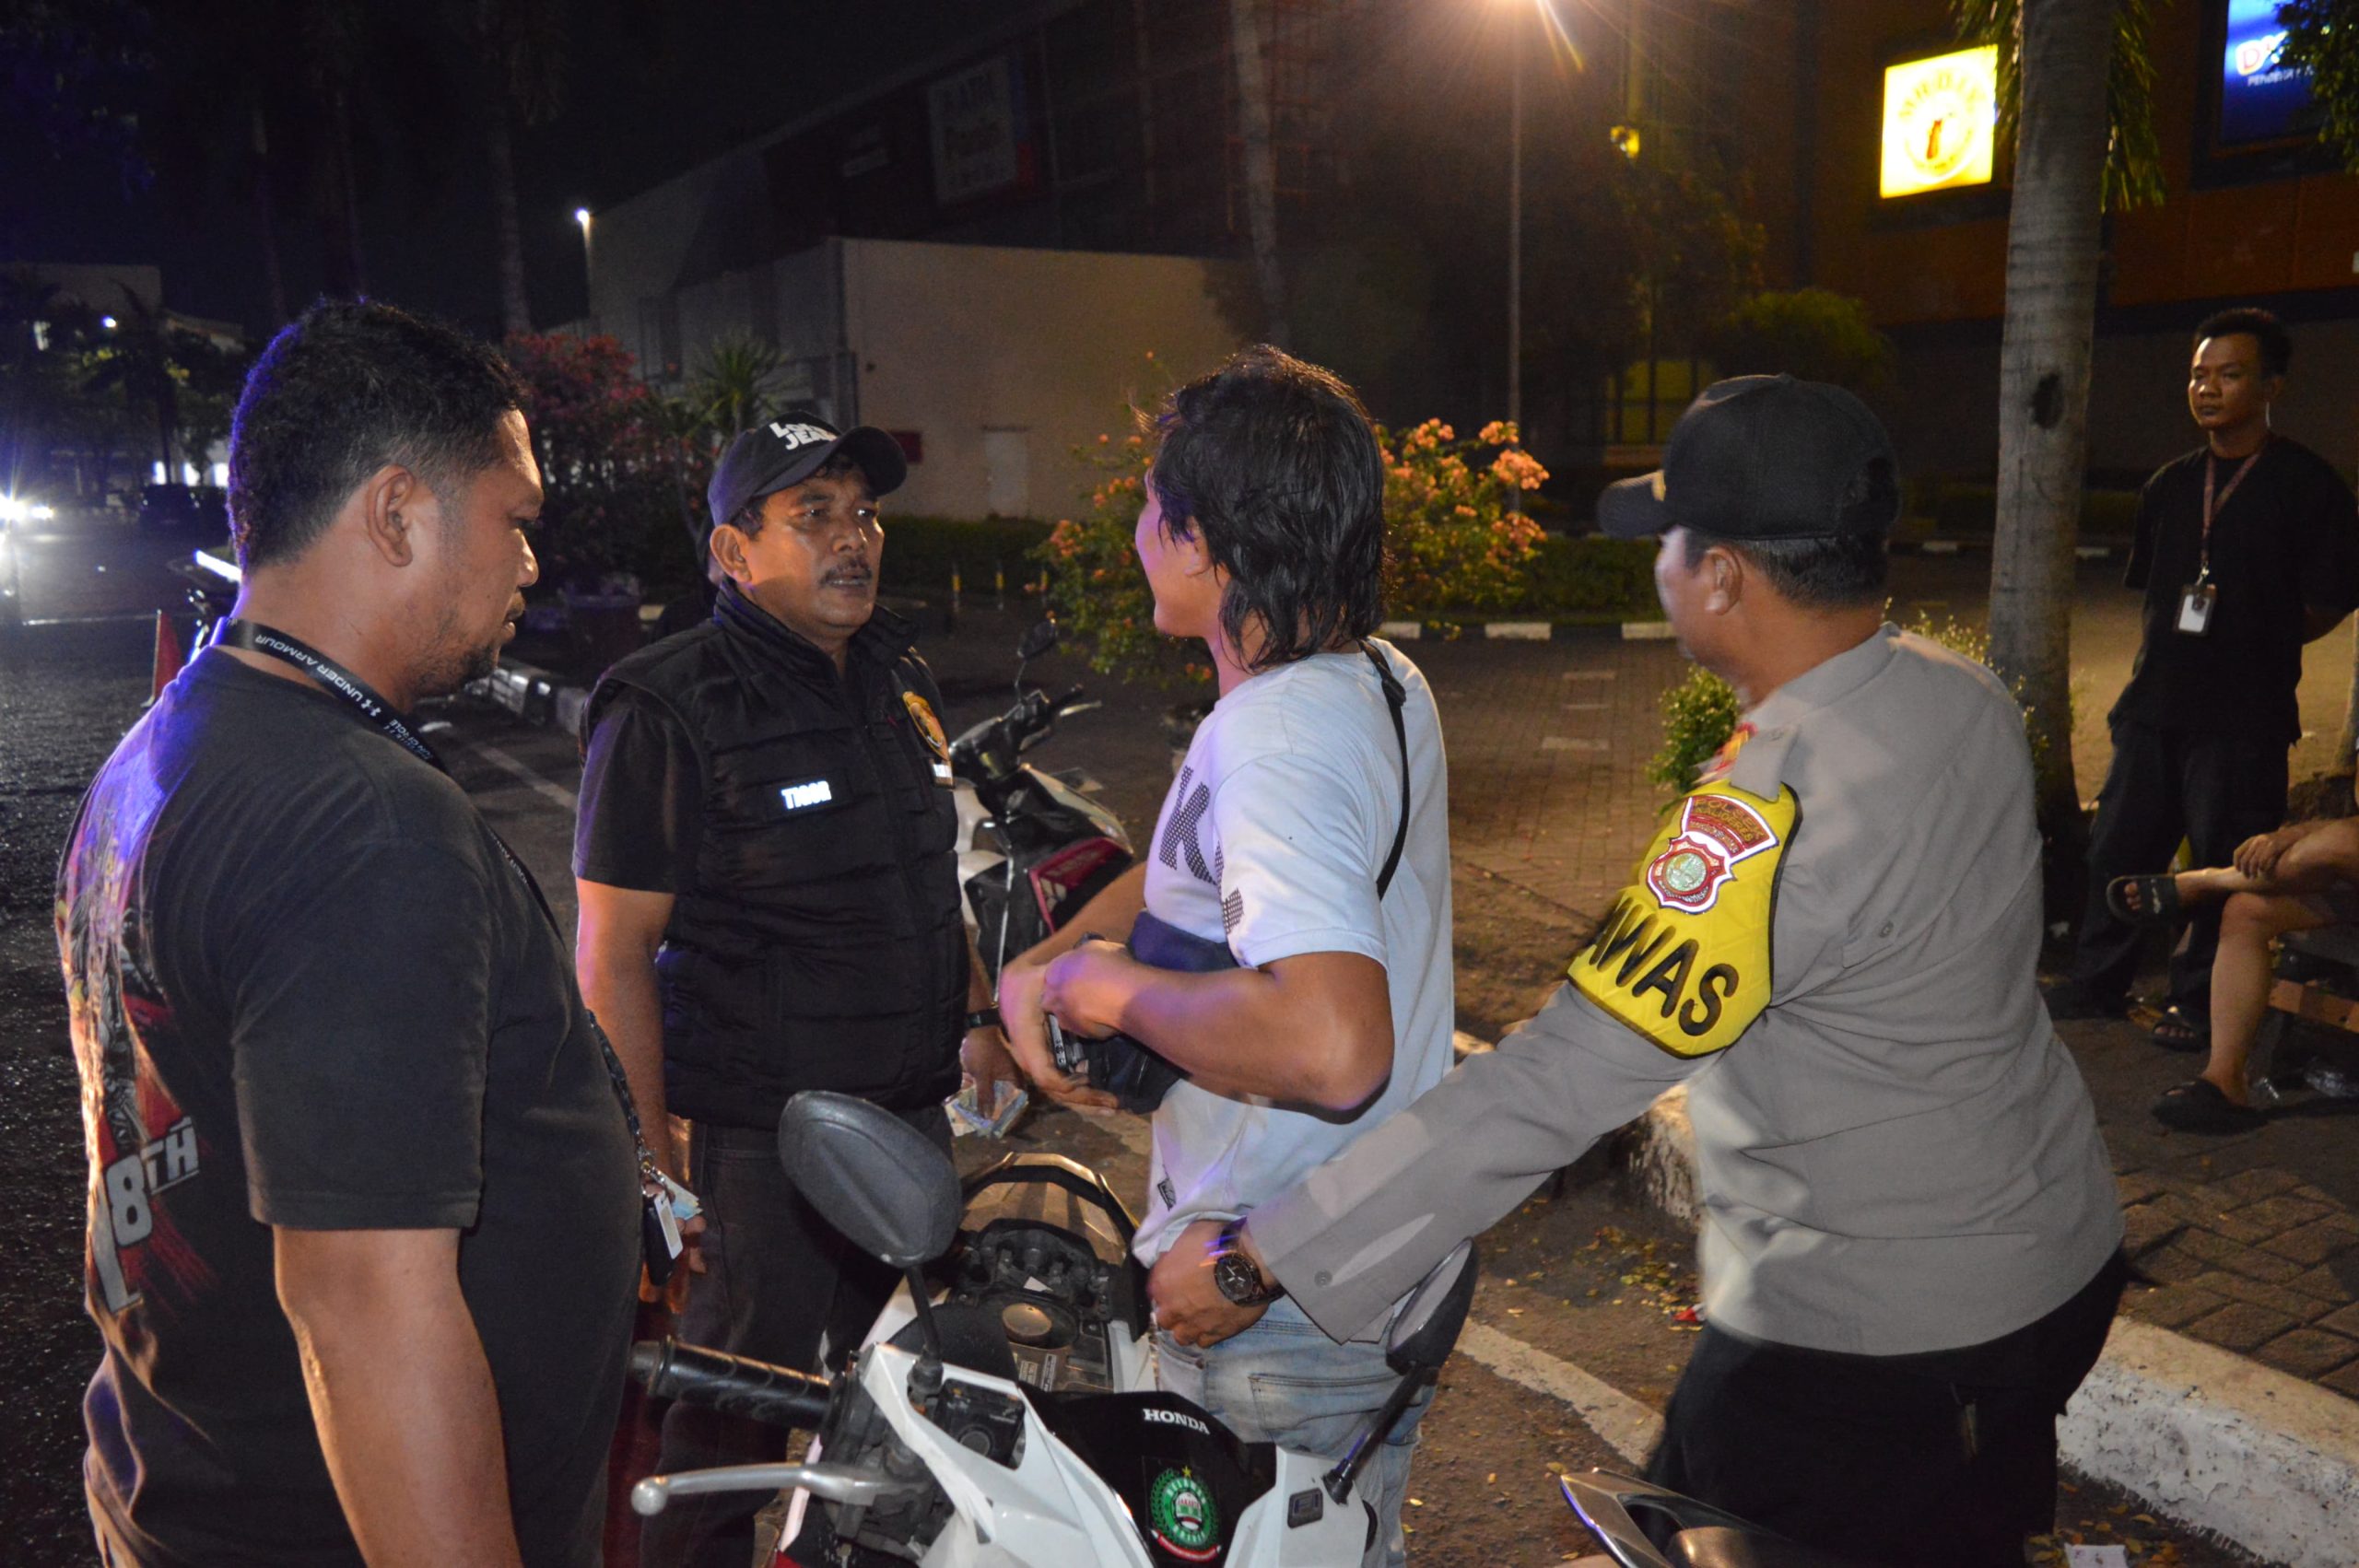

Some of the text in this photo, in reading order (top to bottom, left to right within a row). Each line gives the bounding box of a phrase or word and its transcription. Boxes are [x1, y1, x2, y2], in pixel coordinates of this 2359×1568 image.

[255, 635, 364, 701] UNDER ARMOUR
[1695, 799, 1765, 840] POLSEK
[1143, 1408, 1210, 1435] HONDA
